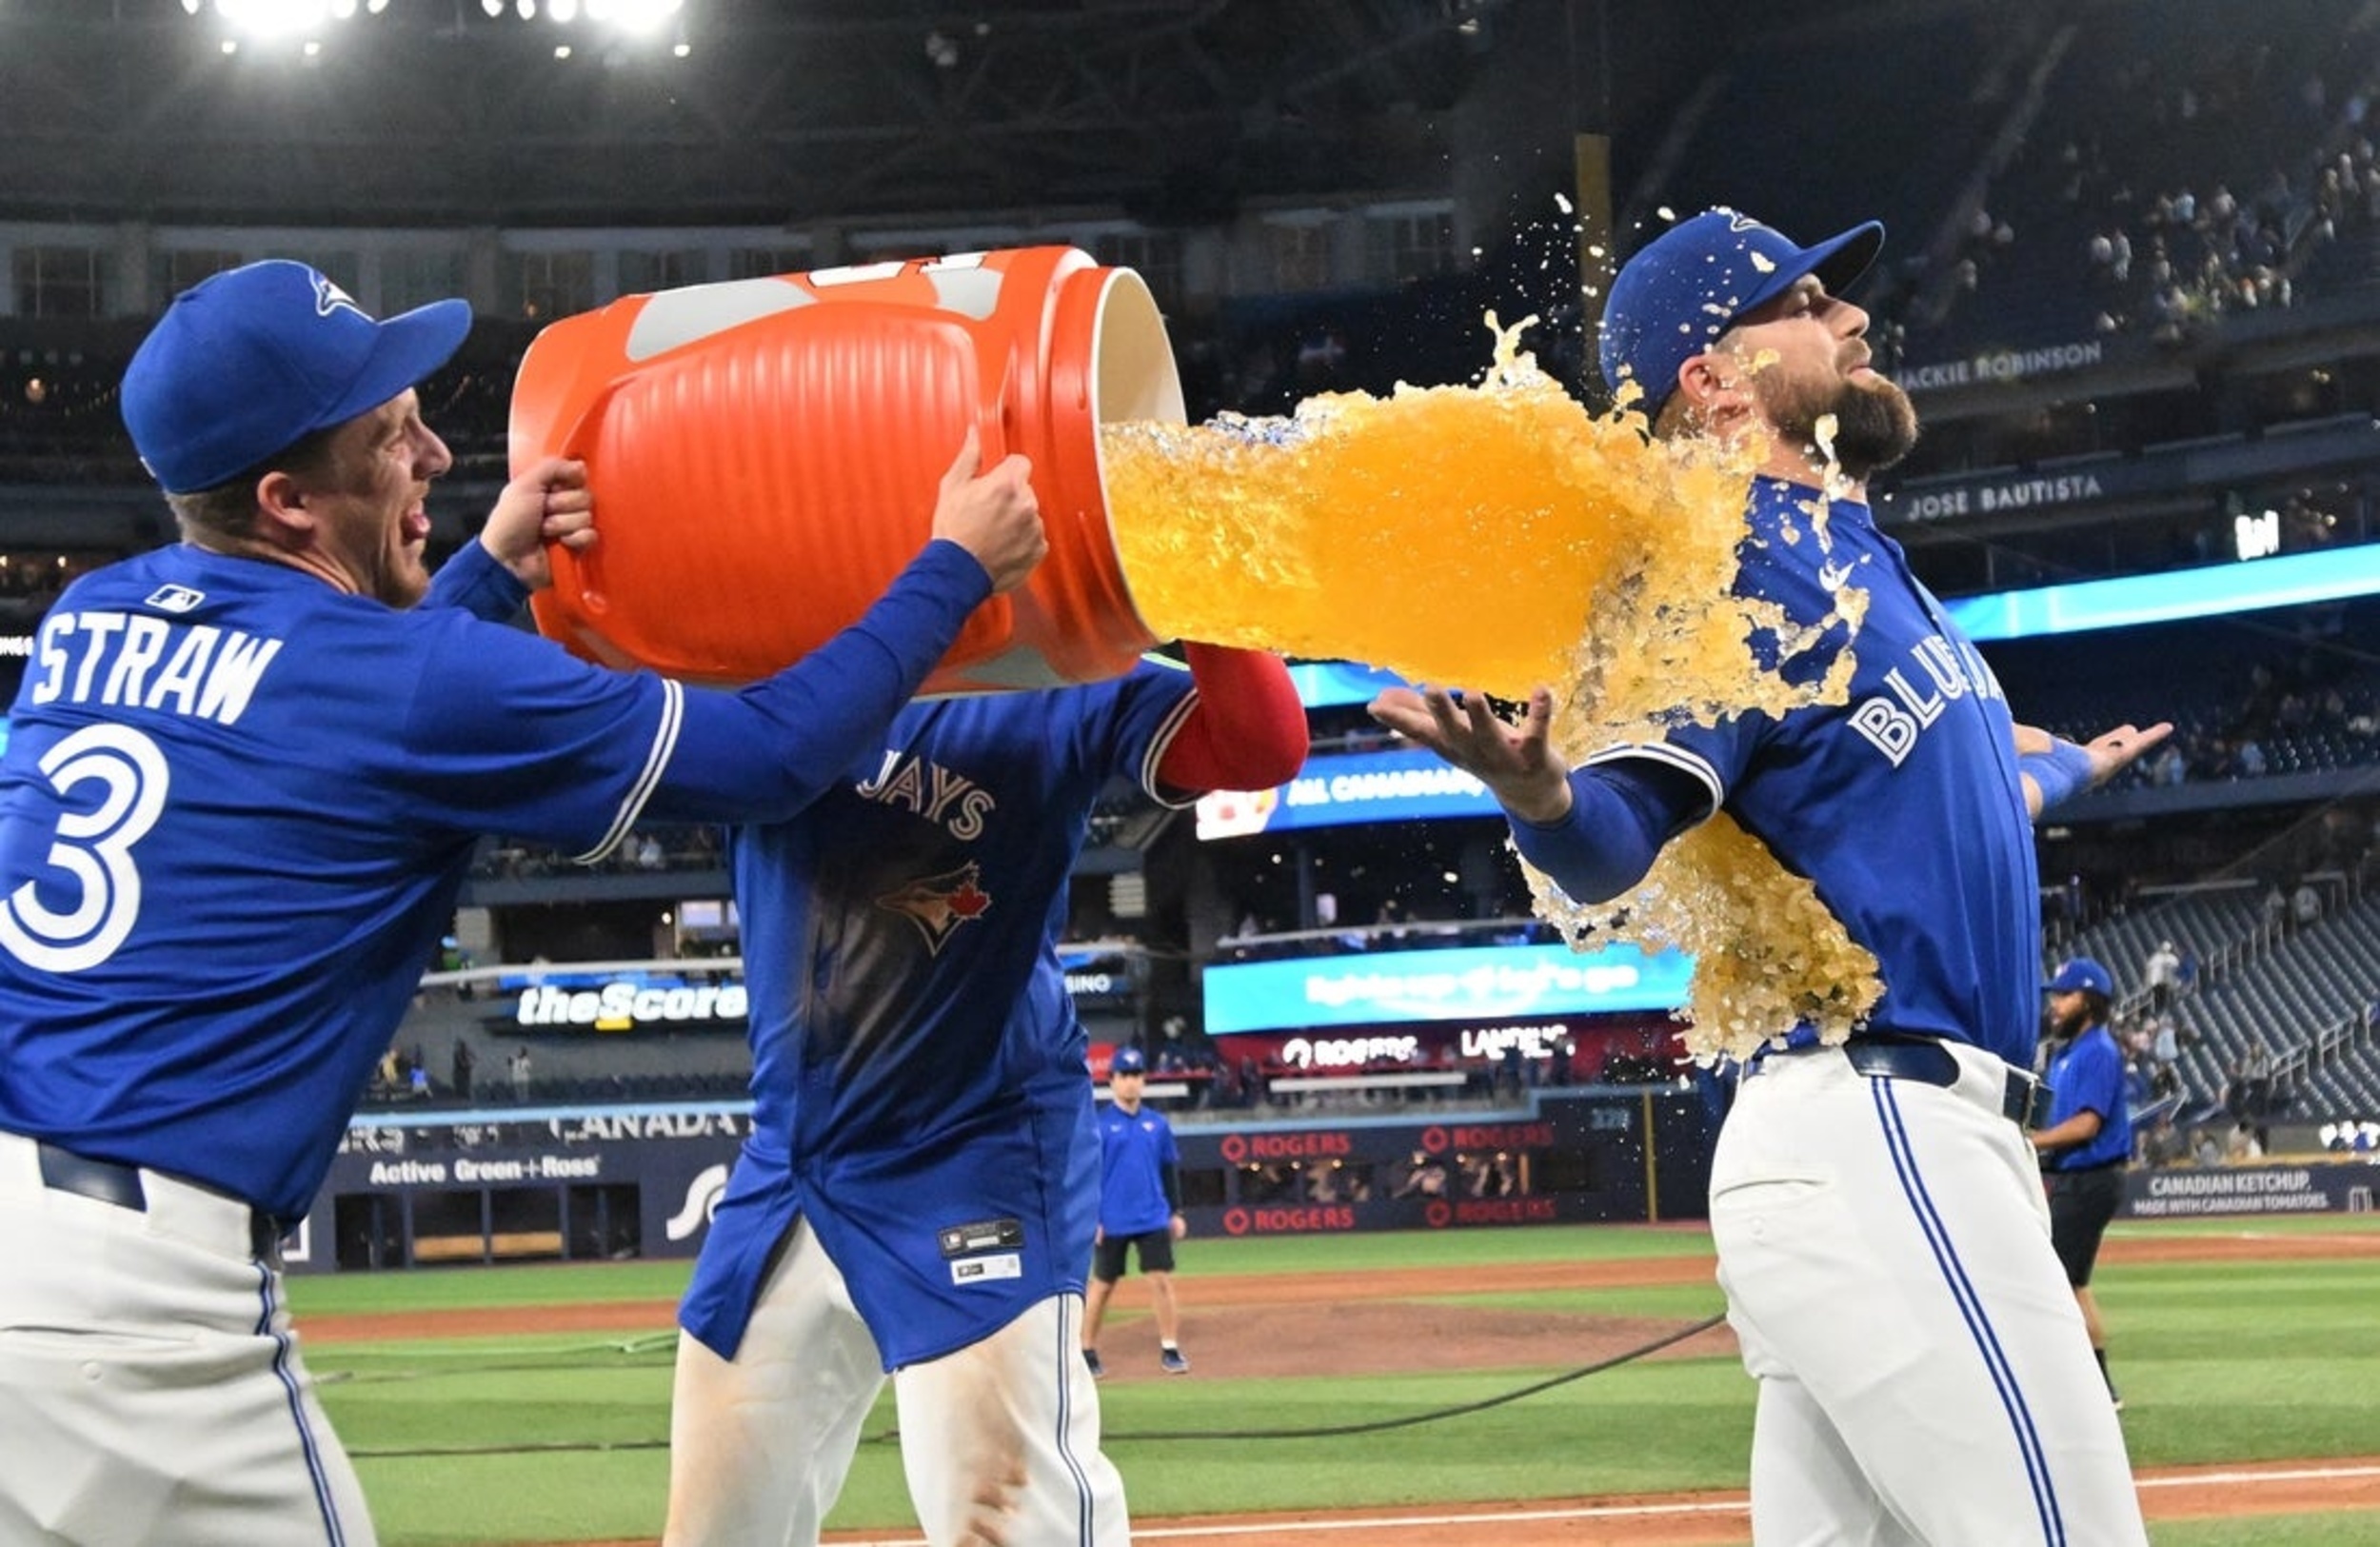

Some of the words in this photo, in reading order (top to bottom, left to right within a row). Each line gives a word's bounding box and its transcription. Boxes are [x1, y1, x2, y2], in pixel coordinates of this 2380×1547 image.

[1974, 341, 2102, 380] ROBINSON
[1907, 489, 1969, 521] JOSE
[1981, 476, 2102, 511] BAUTISTA
[32, 612, 284, 726] STRAW
[856, 749, 996, 841] JAYS
[0, 723, 170, 973] 3
[517, 982, 748, 1025] theScore
[1251, 1133, 1351, 1158] ROGERS
[1453, 1123, 1554, 1148] ROGERS
[369, 1160, 446, 1184] Active
[2151, 1176, 2233, 1197] CANADIAN
[1255, 1206, 1355, 1230] ROGERS
[2132, 1199, 2166, 1215] MADE
[2169, 1199, 2201, 1214] WITH
[2202, 1195, 2263, 1213] CANADIAN
